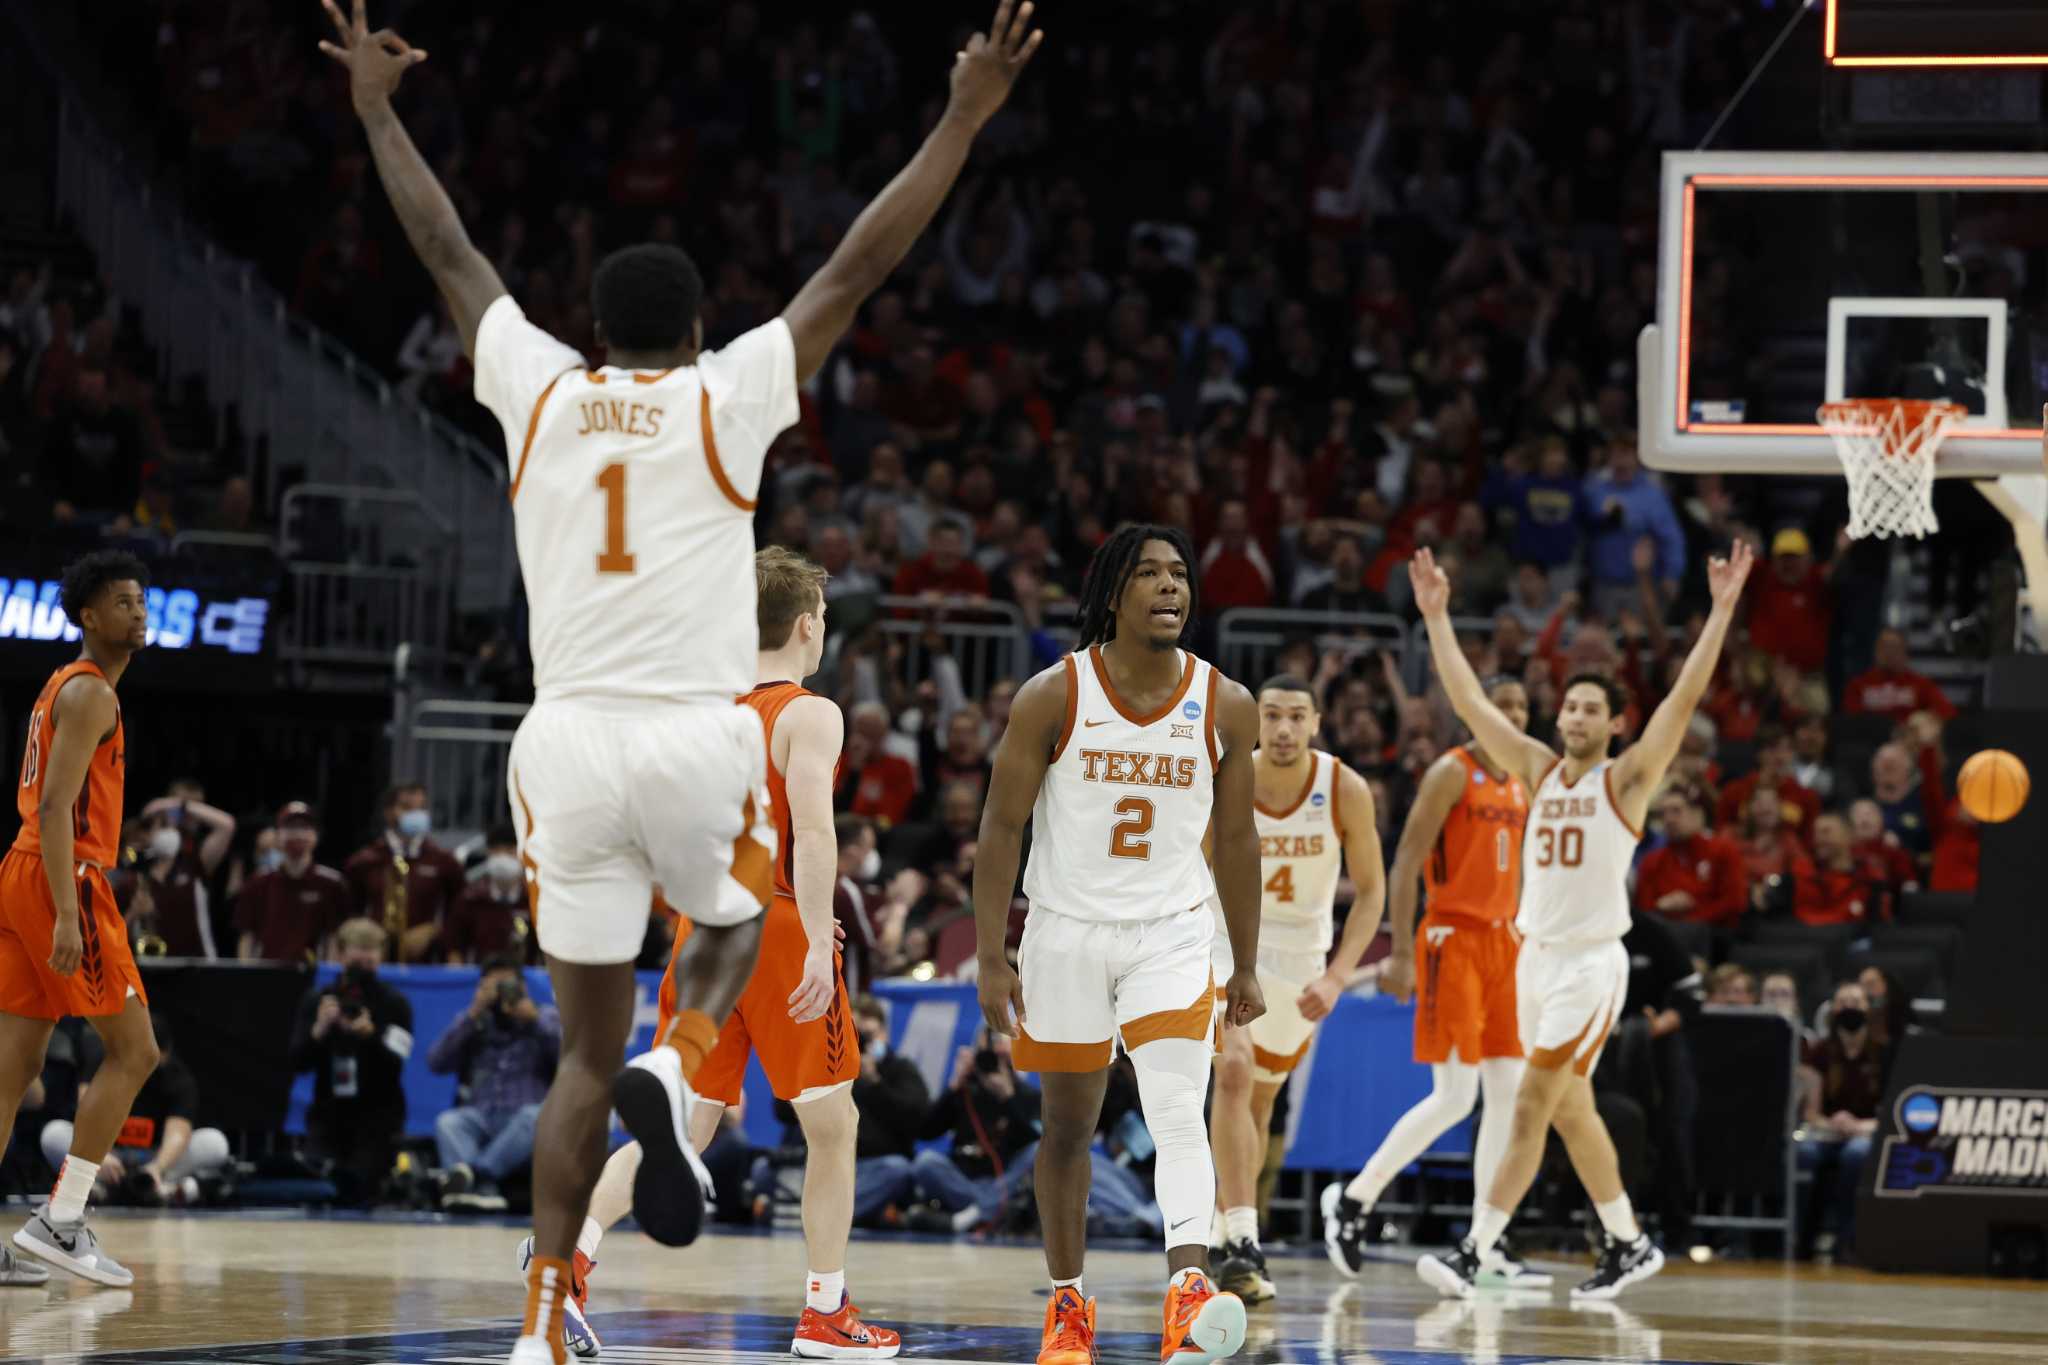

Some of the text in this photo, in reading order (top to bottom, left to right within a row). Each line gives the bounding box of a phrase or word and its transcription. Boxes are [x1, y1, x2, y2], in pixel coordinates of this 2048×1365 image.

[577, 399, 664, 438] JONES
[595, 461, 636, 575] 1
[1080, 748, 1197, 789] TEXAS
[1108, 794, 1155, 861] 2
[1259, 833, 1324, 859] EXAS
[1535, 826, 1584, 868] 30
[1496, 827, 1510, 873] 1
[1264, 864, 1295, 903] 4
[1937, 1096, 2048, 1137] MARC
